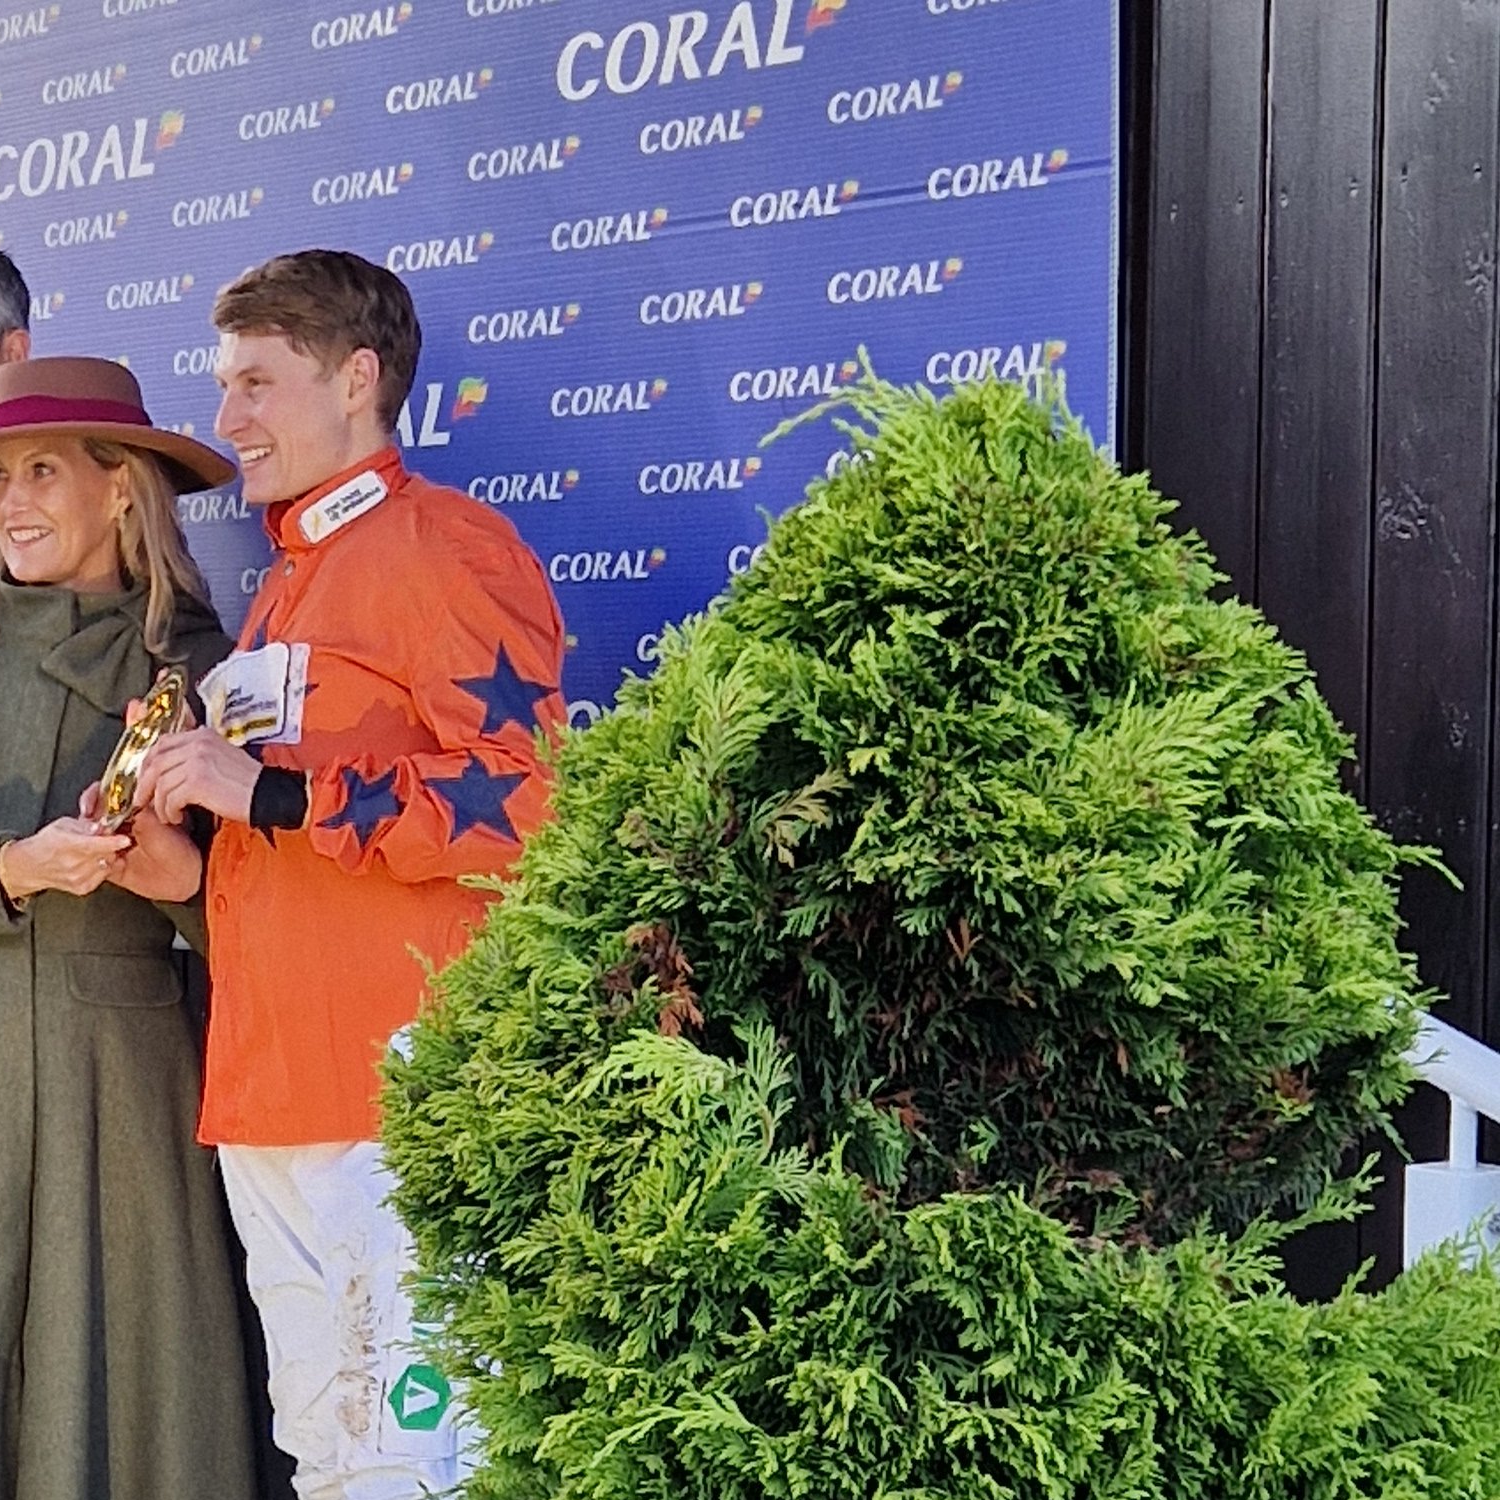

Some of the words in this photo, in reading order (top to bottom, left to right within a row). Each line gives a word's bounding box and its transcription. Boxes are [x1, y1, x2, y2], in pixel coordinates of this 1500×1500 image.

[311, 9, 398, 50] CORAL
[171, 39, 251, 79] CORAL
[557, 0, 805, 100] CORAL
[43, 70, 115, 105] CORAL
[386, 73, 478, 114] CORAL
[828, 76, 944, 124] CORAL
[239, 103, 322, 141] CORAL
[640, 110, 745, 154] CORAL
[468, 140, 564, 181] CORAL
[928, 153, 1050, 200] CORAL
[312, 169, 400, 206] CORAL
[730, 185, 842, 228] CORAL
[172, 193, 251, 227] CORAL
[45, 214, 116, 248] CORAL
[551, 211, 652, 252] CORAL
[386, 236, 479, 272] CORAL
[106, 277, 182, 310] CORAL
[828, 262, 944, 304] CORAL
[468, 306, 564, 343] CORAL
[640, 285, 746, 325] CORAL
[174, 346, 220, 375] COR
[926, 343, 1046, 384] CORAL
[551, 382, 652, 418] CORAL
[730, 363, 841, 402] CORAL
[468, 473, 564, 503] CORAL
[639, 461, 745, 496] CORAL
[550, 550, 650, 582] CORAL
